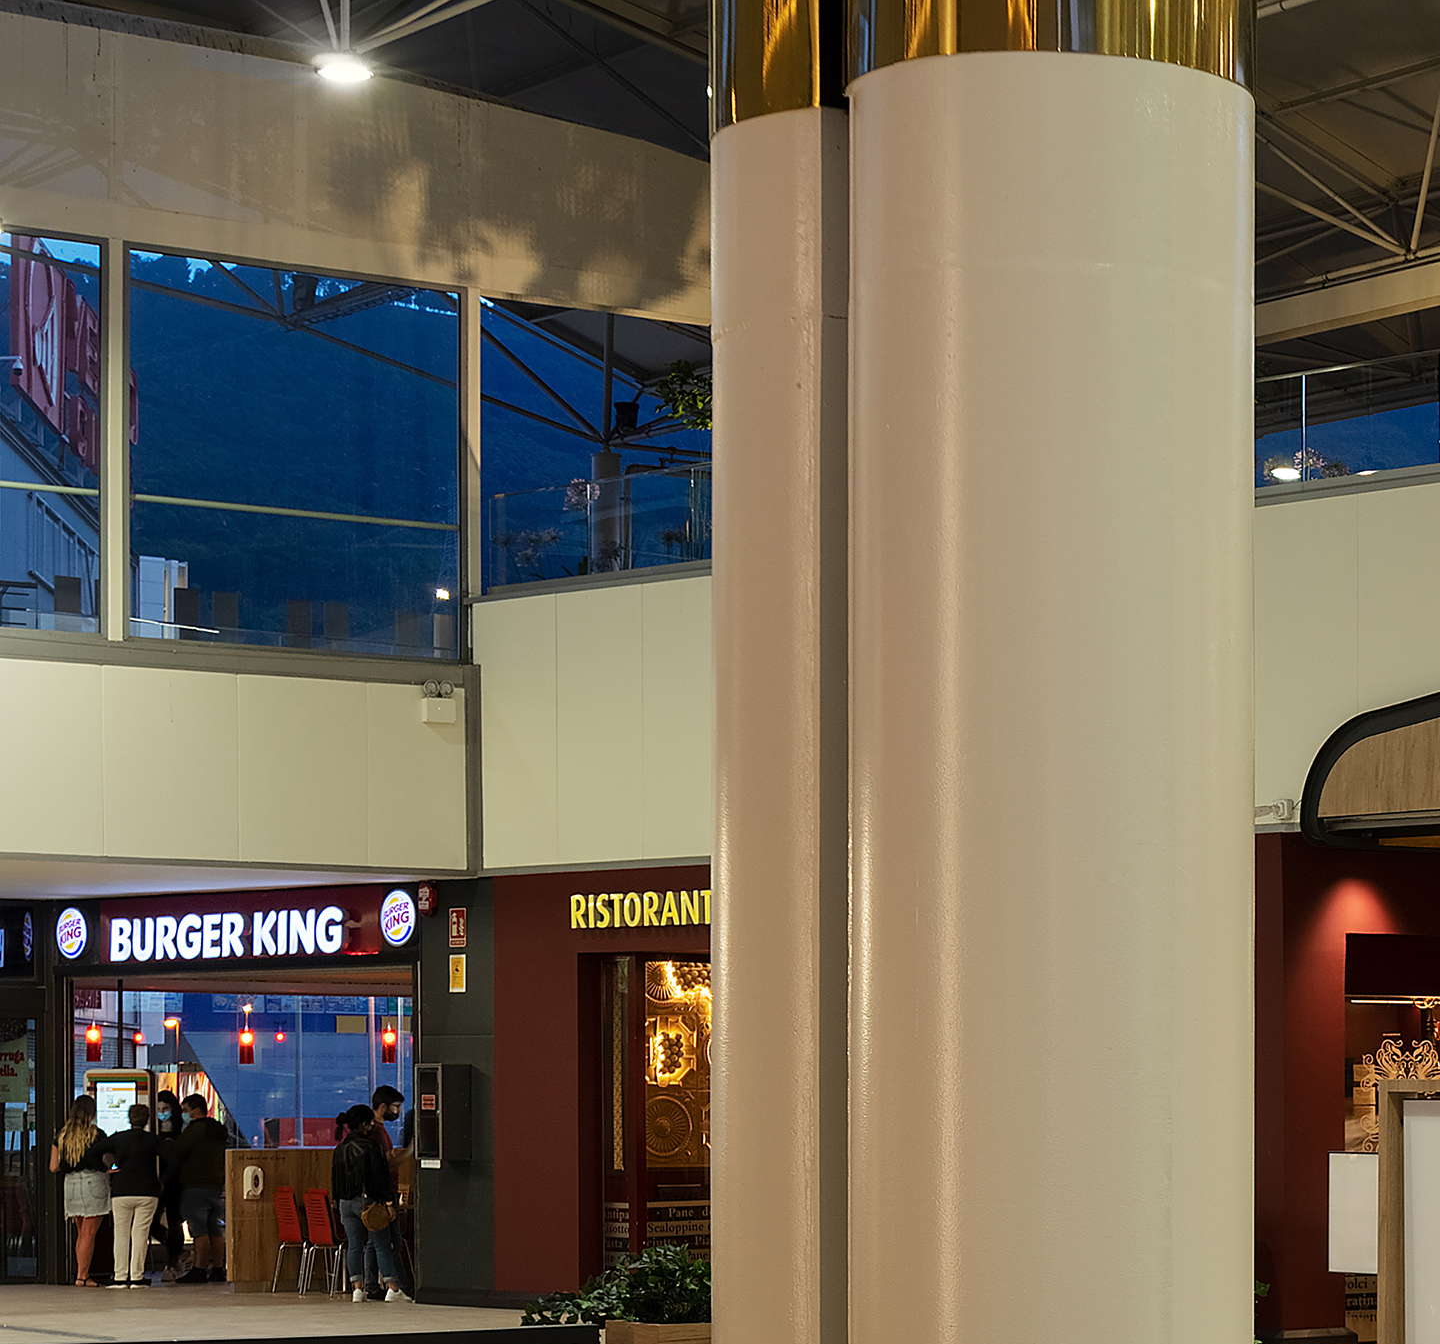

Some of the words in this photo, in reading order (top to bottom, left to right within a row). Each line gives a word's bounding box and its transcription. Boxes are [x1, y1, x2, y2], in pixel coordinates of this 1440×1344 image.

[383, 901, 409, 919] BURGER
[570, 890, 711, 929] RISTORANT
[58, 918, 81, 934] BURGER
[384, 911, 409, 931] KING
[59, 926, 82, 944] KING
[110, 913, 243, 961] BURGER
[253, 906, 342, 956] KING
[668, 1207, 694, 1218] Pane
[647, 1220, 704, 1234] Scaloppine
